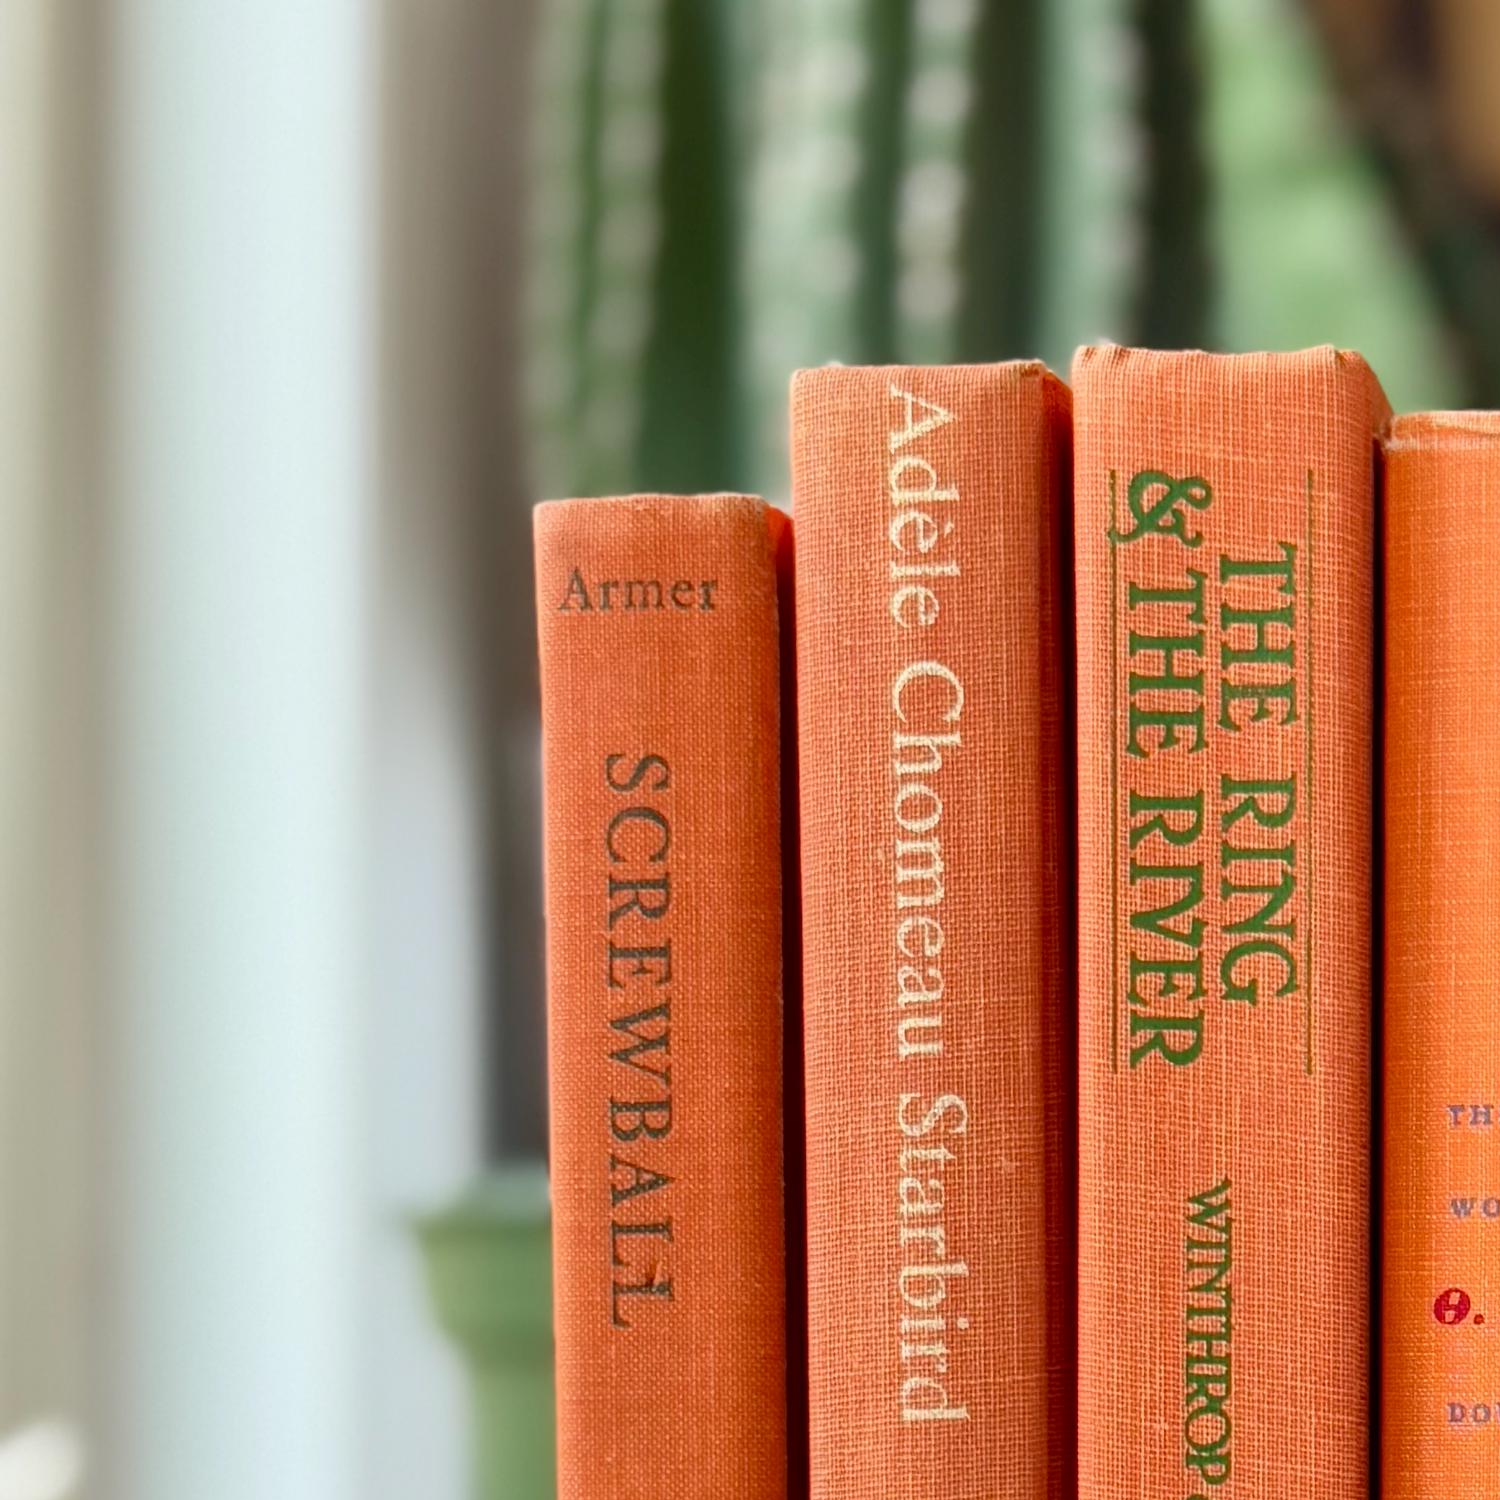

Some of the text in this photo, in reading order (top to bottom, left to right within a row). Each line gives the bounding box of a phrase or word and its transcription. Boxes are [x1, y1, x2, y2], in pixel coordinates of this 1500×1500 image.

[558, 567, 719, 613] Armer
[1106, 469, 1213, 1070] & THE RIVER
[1218, 541, 1299, 1007] THE RING
[604, 752, 675, 1329] SCREWBALL
[889, 383, 970, 1424] Adèle Chomeau Starbird
[1184, 1176, 1236, 1486] WINTHROP
